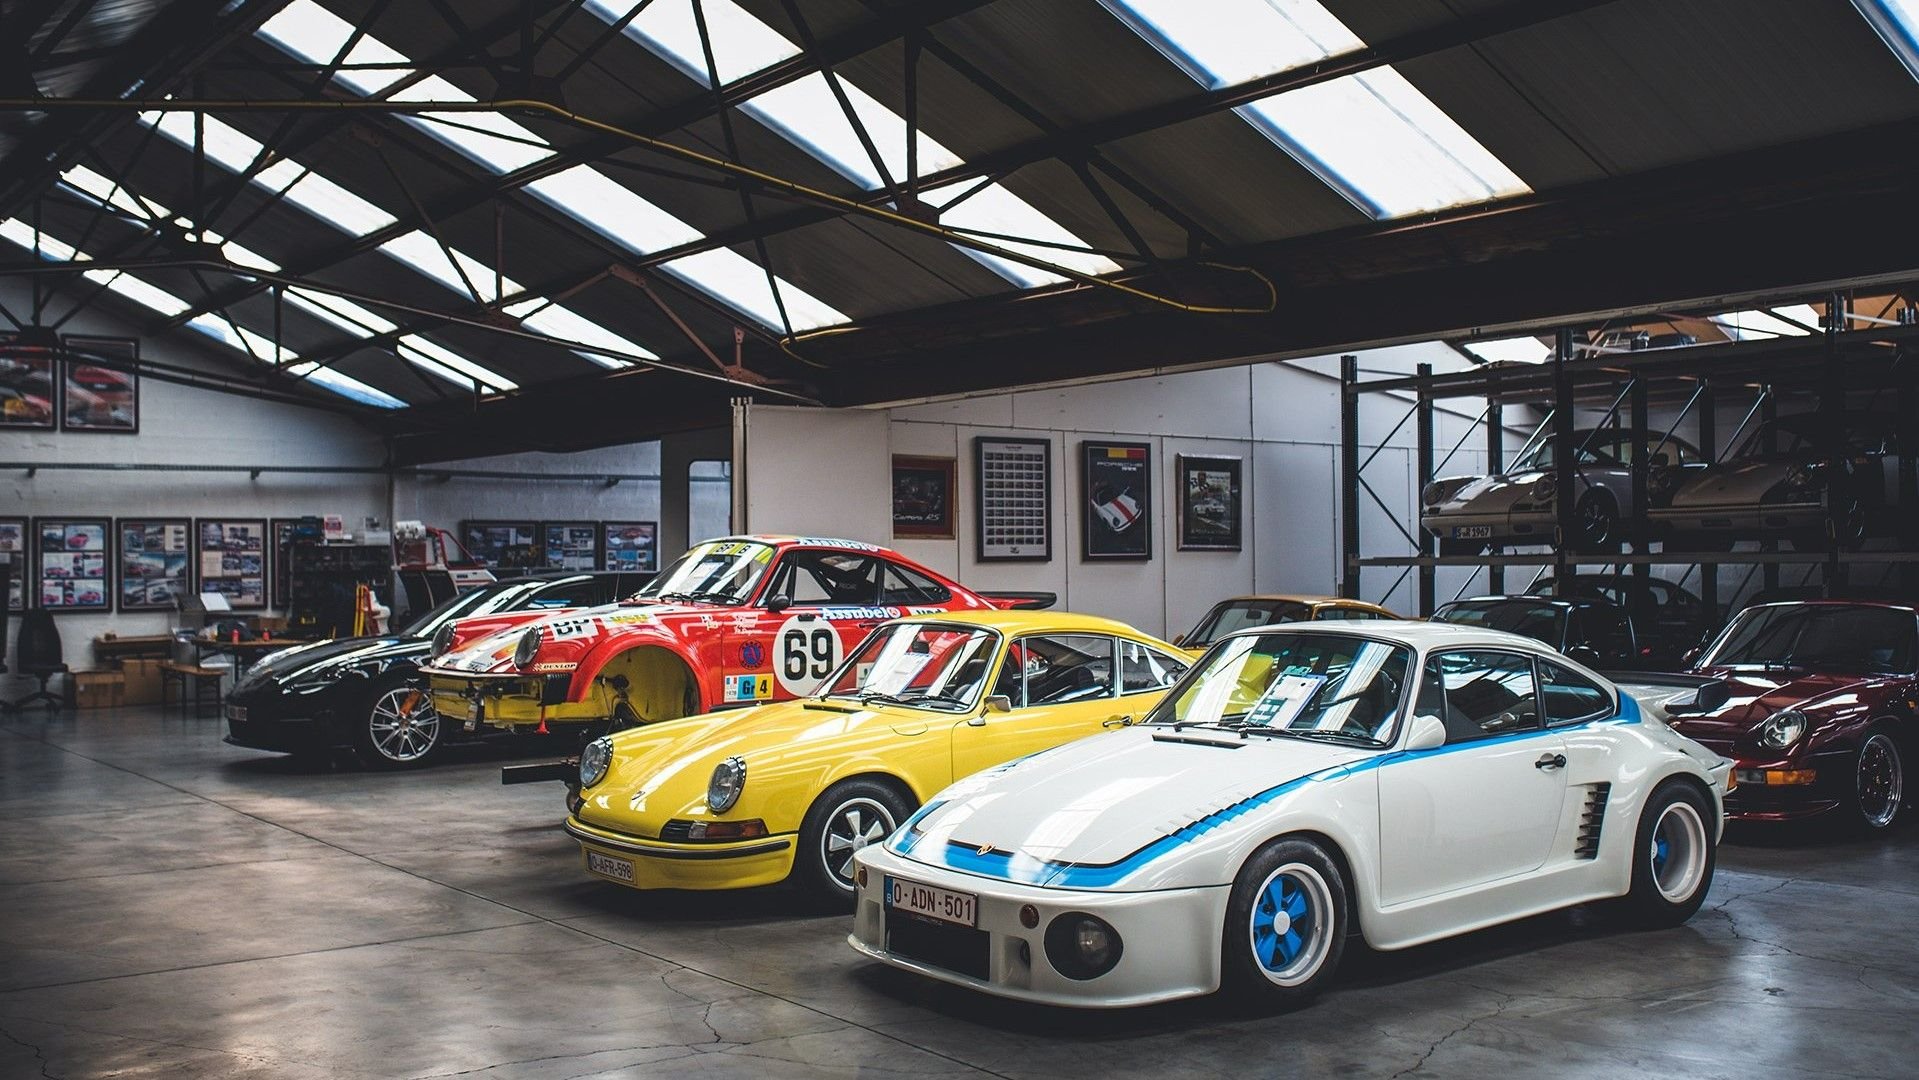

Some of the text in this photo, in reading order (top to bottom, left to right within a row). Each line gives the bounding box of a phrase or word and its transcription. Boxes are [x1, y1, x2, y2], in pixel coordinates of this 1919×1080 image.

[822, 607, 889, 620] Assubel
[784, 629, 833, 681] 69
[743, 679, 768, 695] Gr 4
